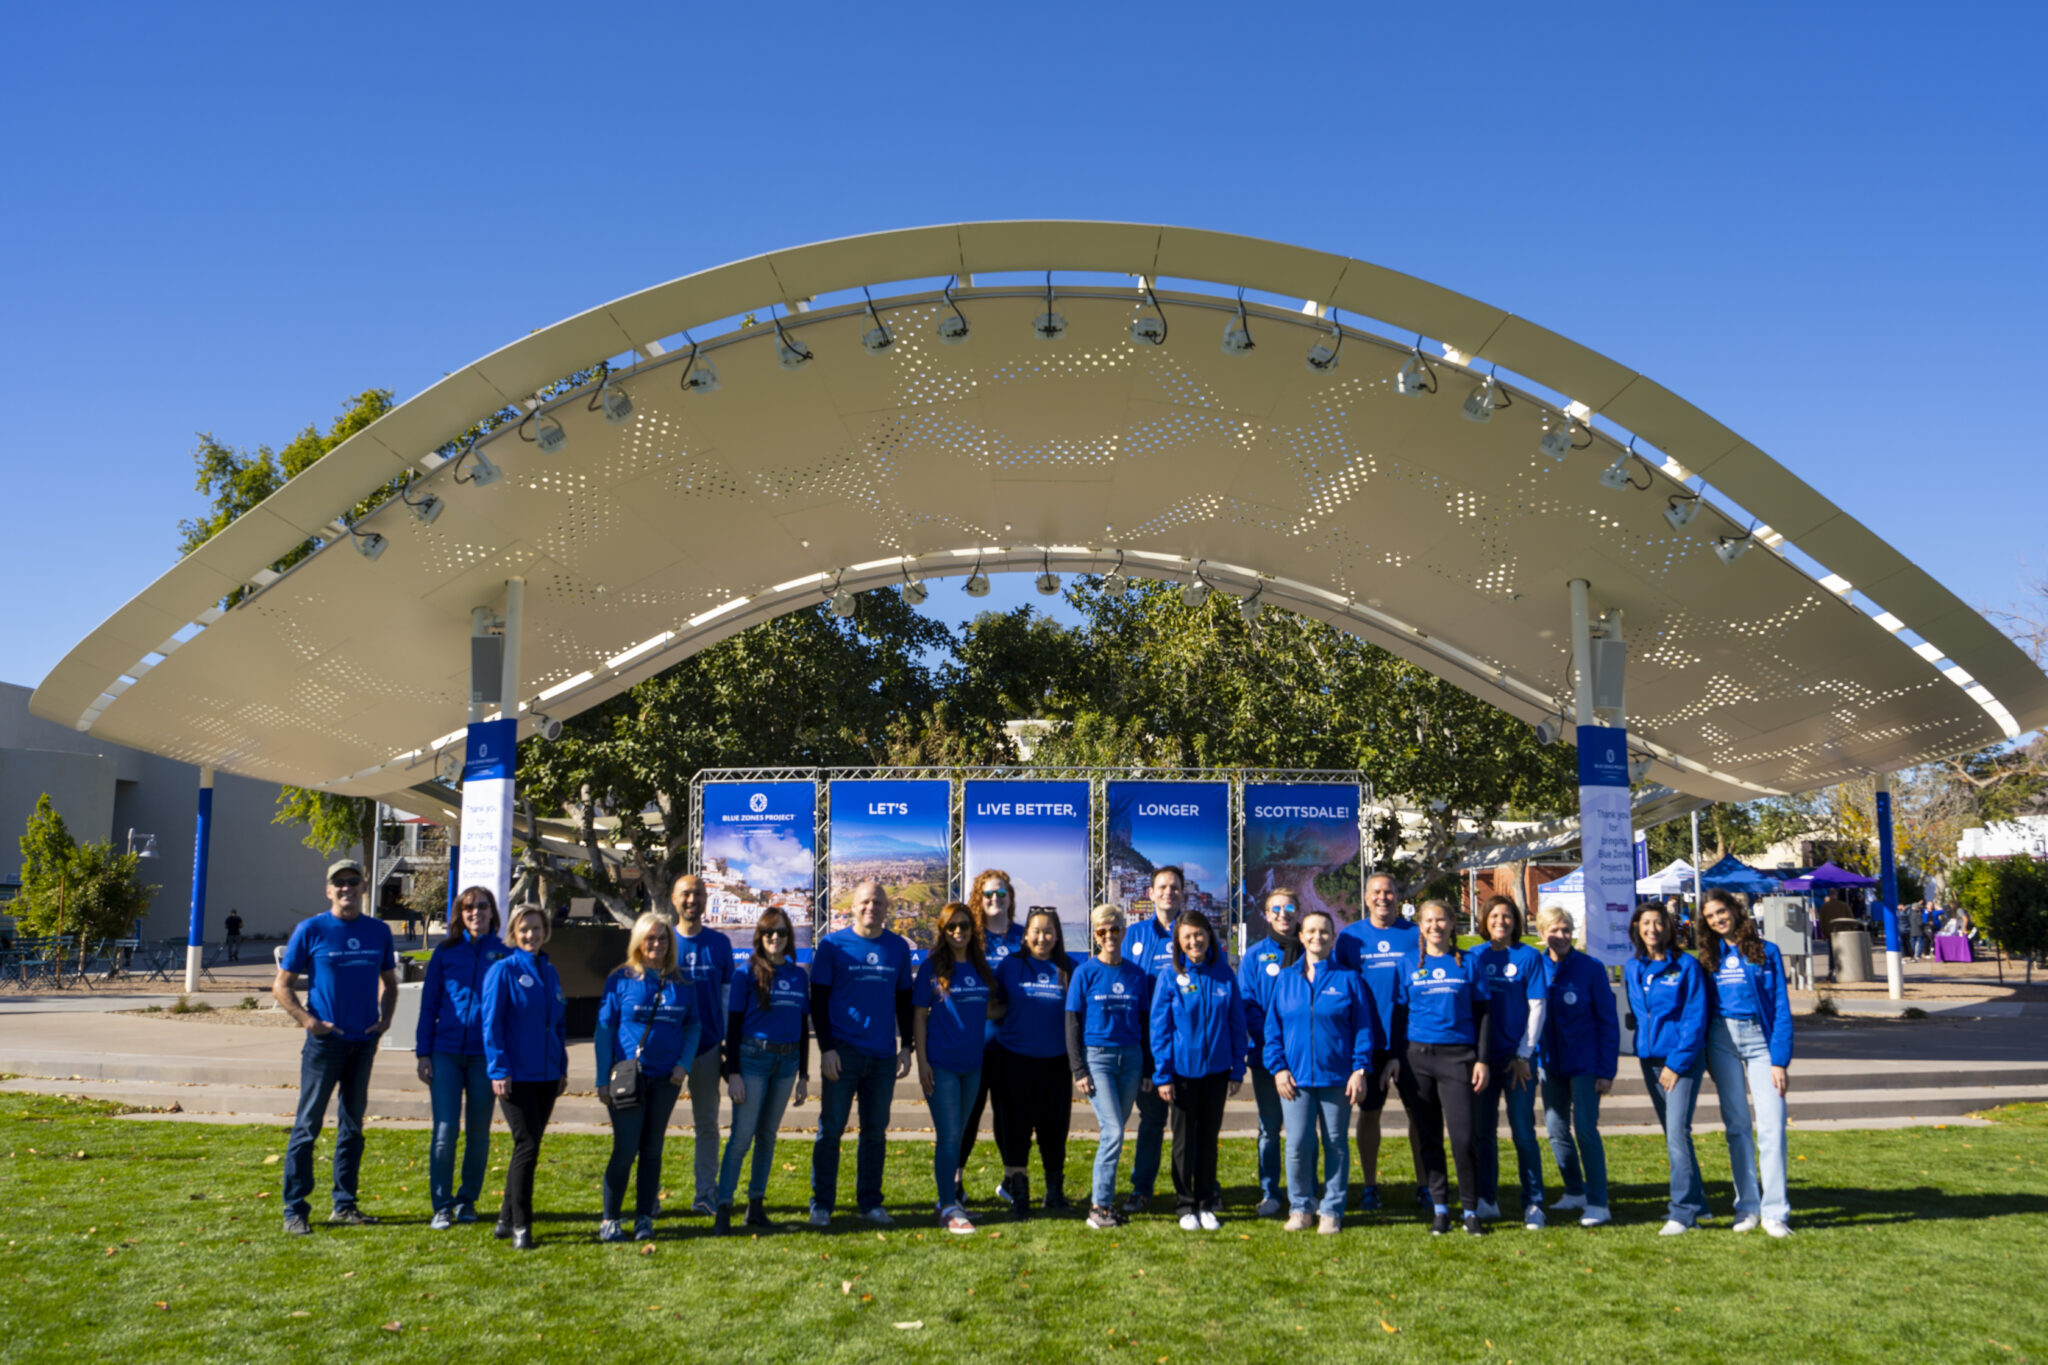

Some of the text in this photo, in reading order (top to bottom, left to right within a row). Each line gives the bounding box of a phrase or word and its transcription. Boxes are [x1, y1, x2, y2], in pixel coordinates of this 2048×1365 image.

[868, 803, 908, 815] LET'S
[977, 803, 1077, 818] LIVE BETTER,
[1138, 804, 1200, 817] LONGER
[1254, 805, 1350, 819] SCOTTSDALE!
[1597, 809, 1629, 820] Thank you
[741, 814, 764, 822] ZONES
[1609, 823, 1618, 832] for
[1601, 837, 1628, 847] bringing
[1598, 849, 1612, 858] Blue
[1600, 862, 1623, 873] Project
[1600, 876, 1633, 886] Scottsdale
